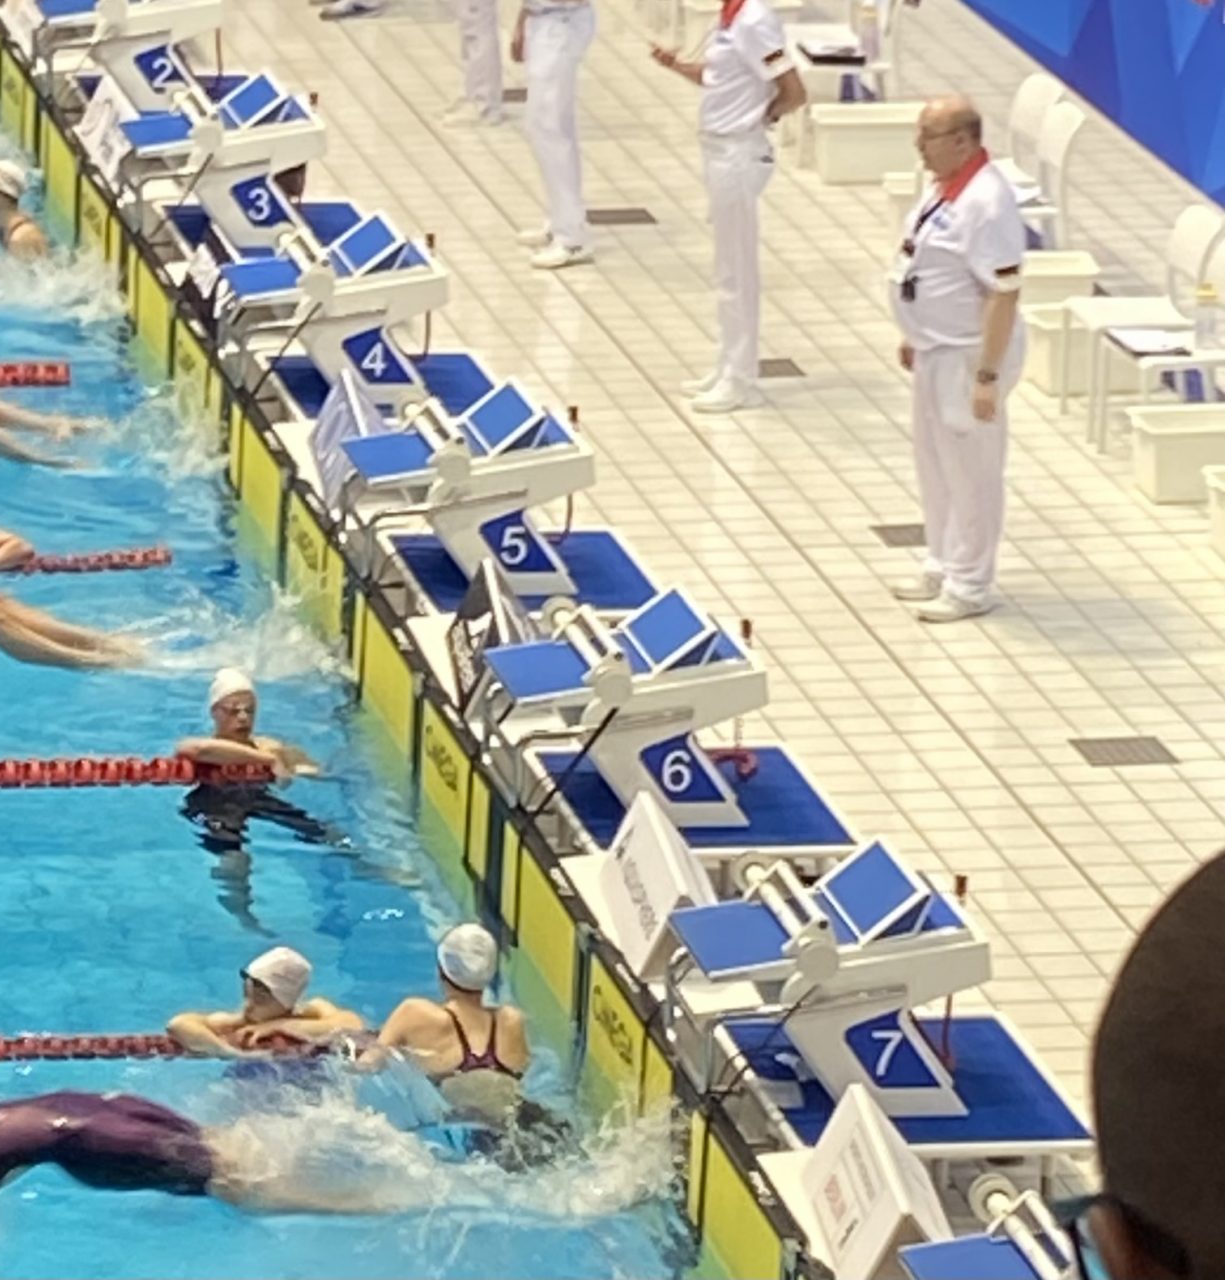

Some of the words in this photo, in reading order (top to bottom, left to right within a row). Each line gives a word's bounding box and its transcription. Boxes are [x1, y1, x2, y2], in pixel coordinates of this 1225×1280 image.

[151, 57, 174, 88] 2
[247, 187, 271, 221] 3
[360, 341, 387, 378] 4
[499, 526, 528, 565] 5
[662, 749, 692, 792] 6
[871, 1030, 904, 1076] 7
